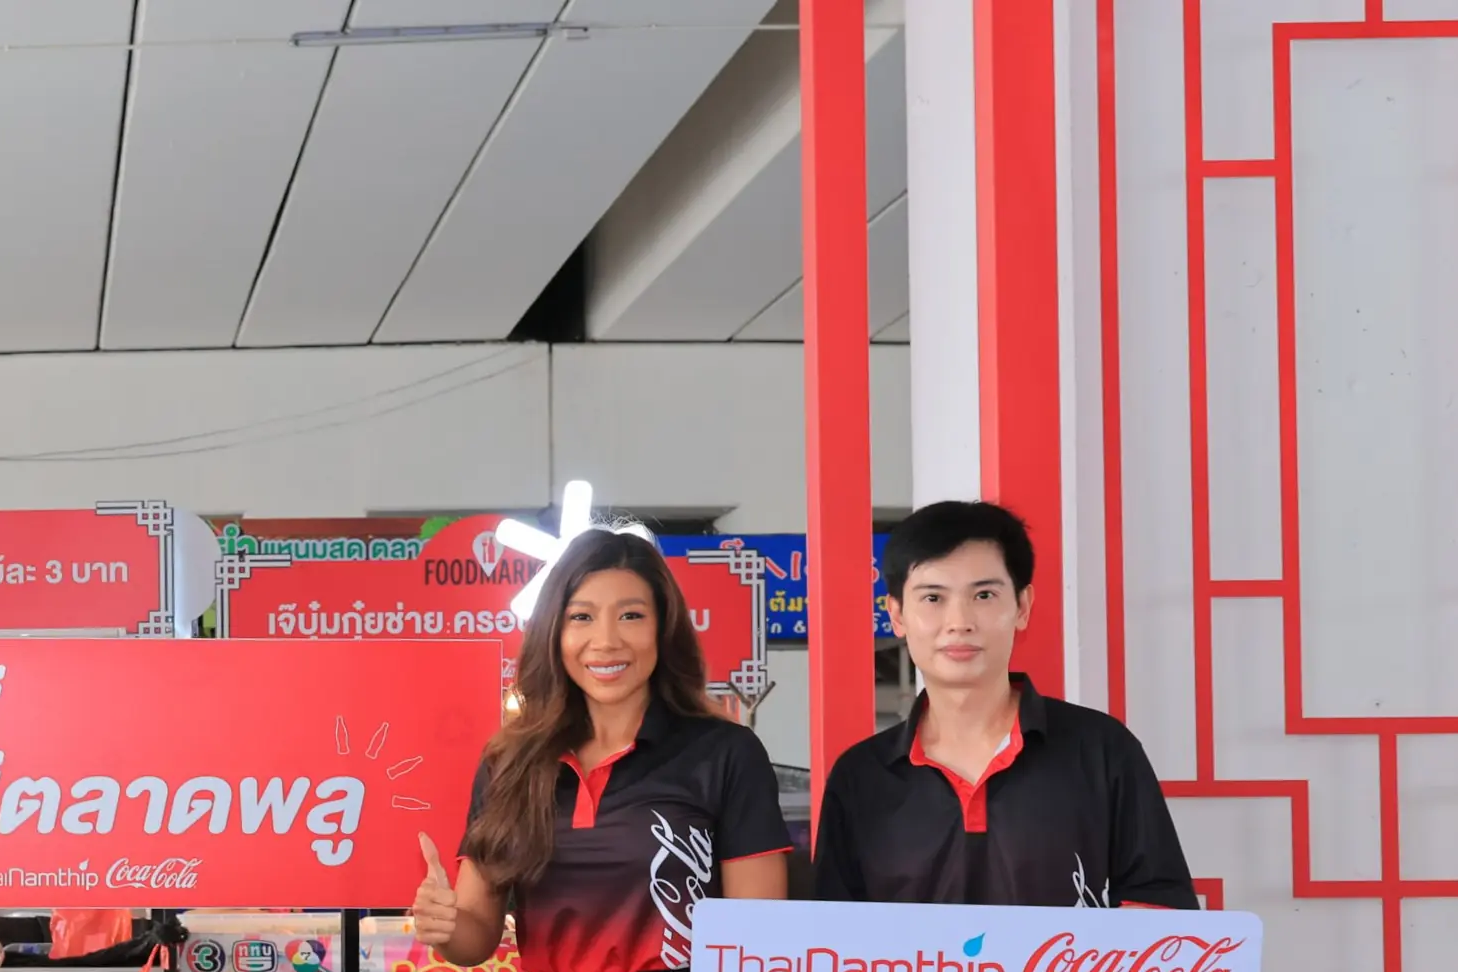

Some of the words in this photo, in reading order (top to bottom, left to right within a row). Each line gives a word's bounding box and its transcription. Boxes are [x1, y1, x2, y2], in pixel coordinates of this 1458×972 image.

[371, 539, 421, 560] ตลา
[45, 559, 64, 584] 3
[71, 560, 129, 584] บาท
[105, 857, 204, 889] Coca-Cola
